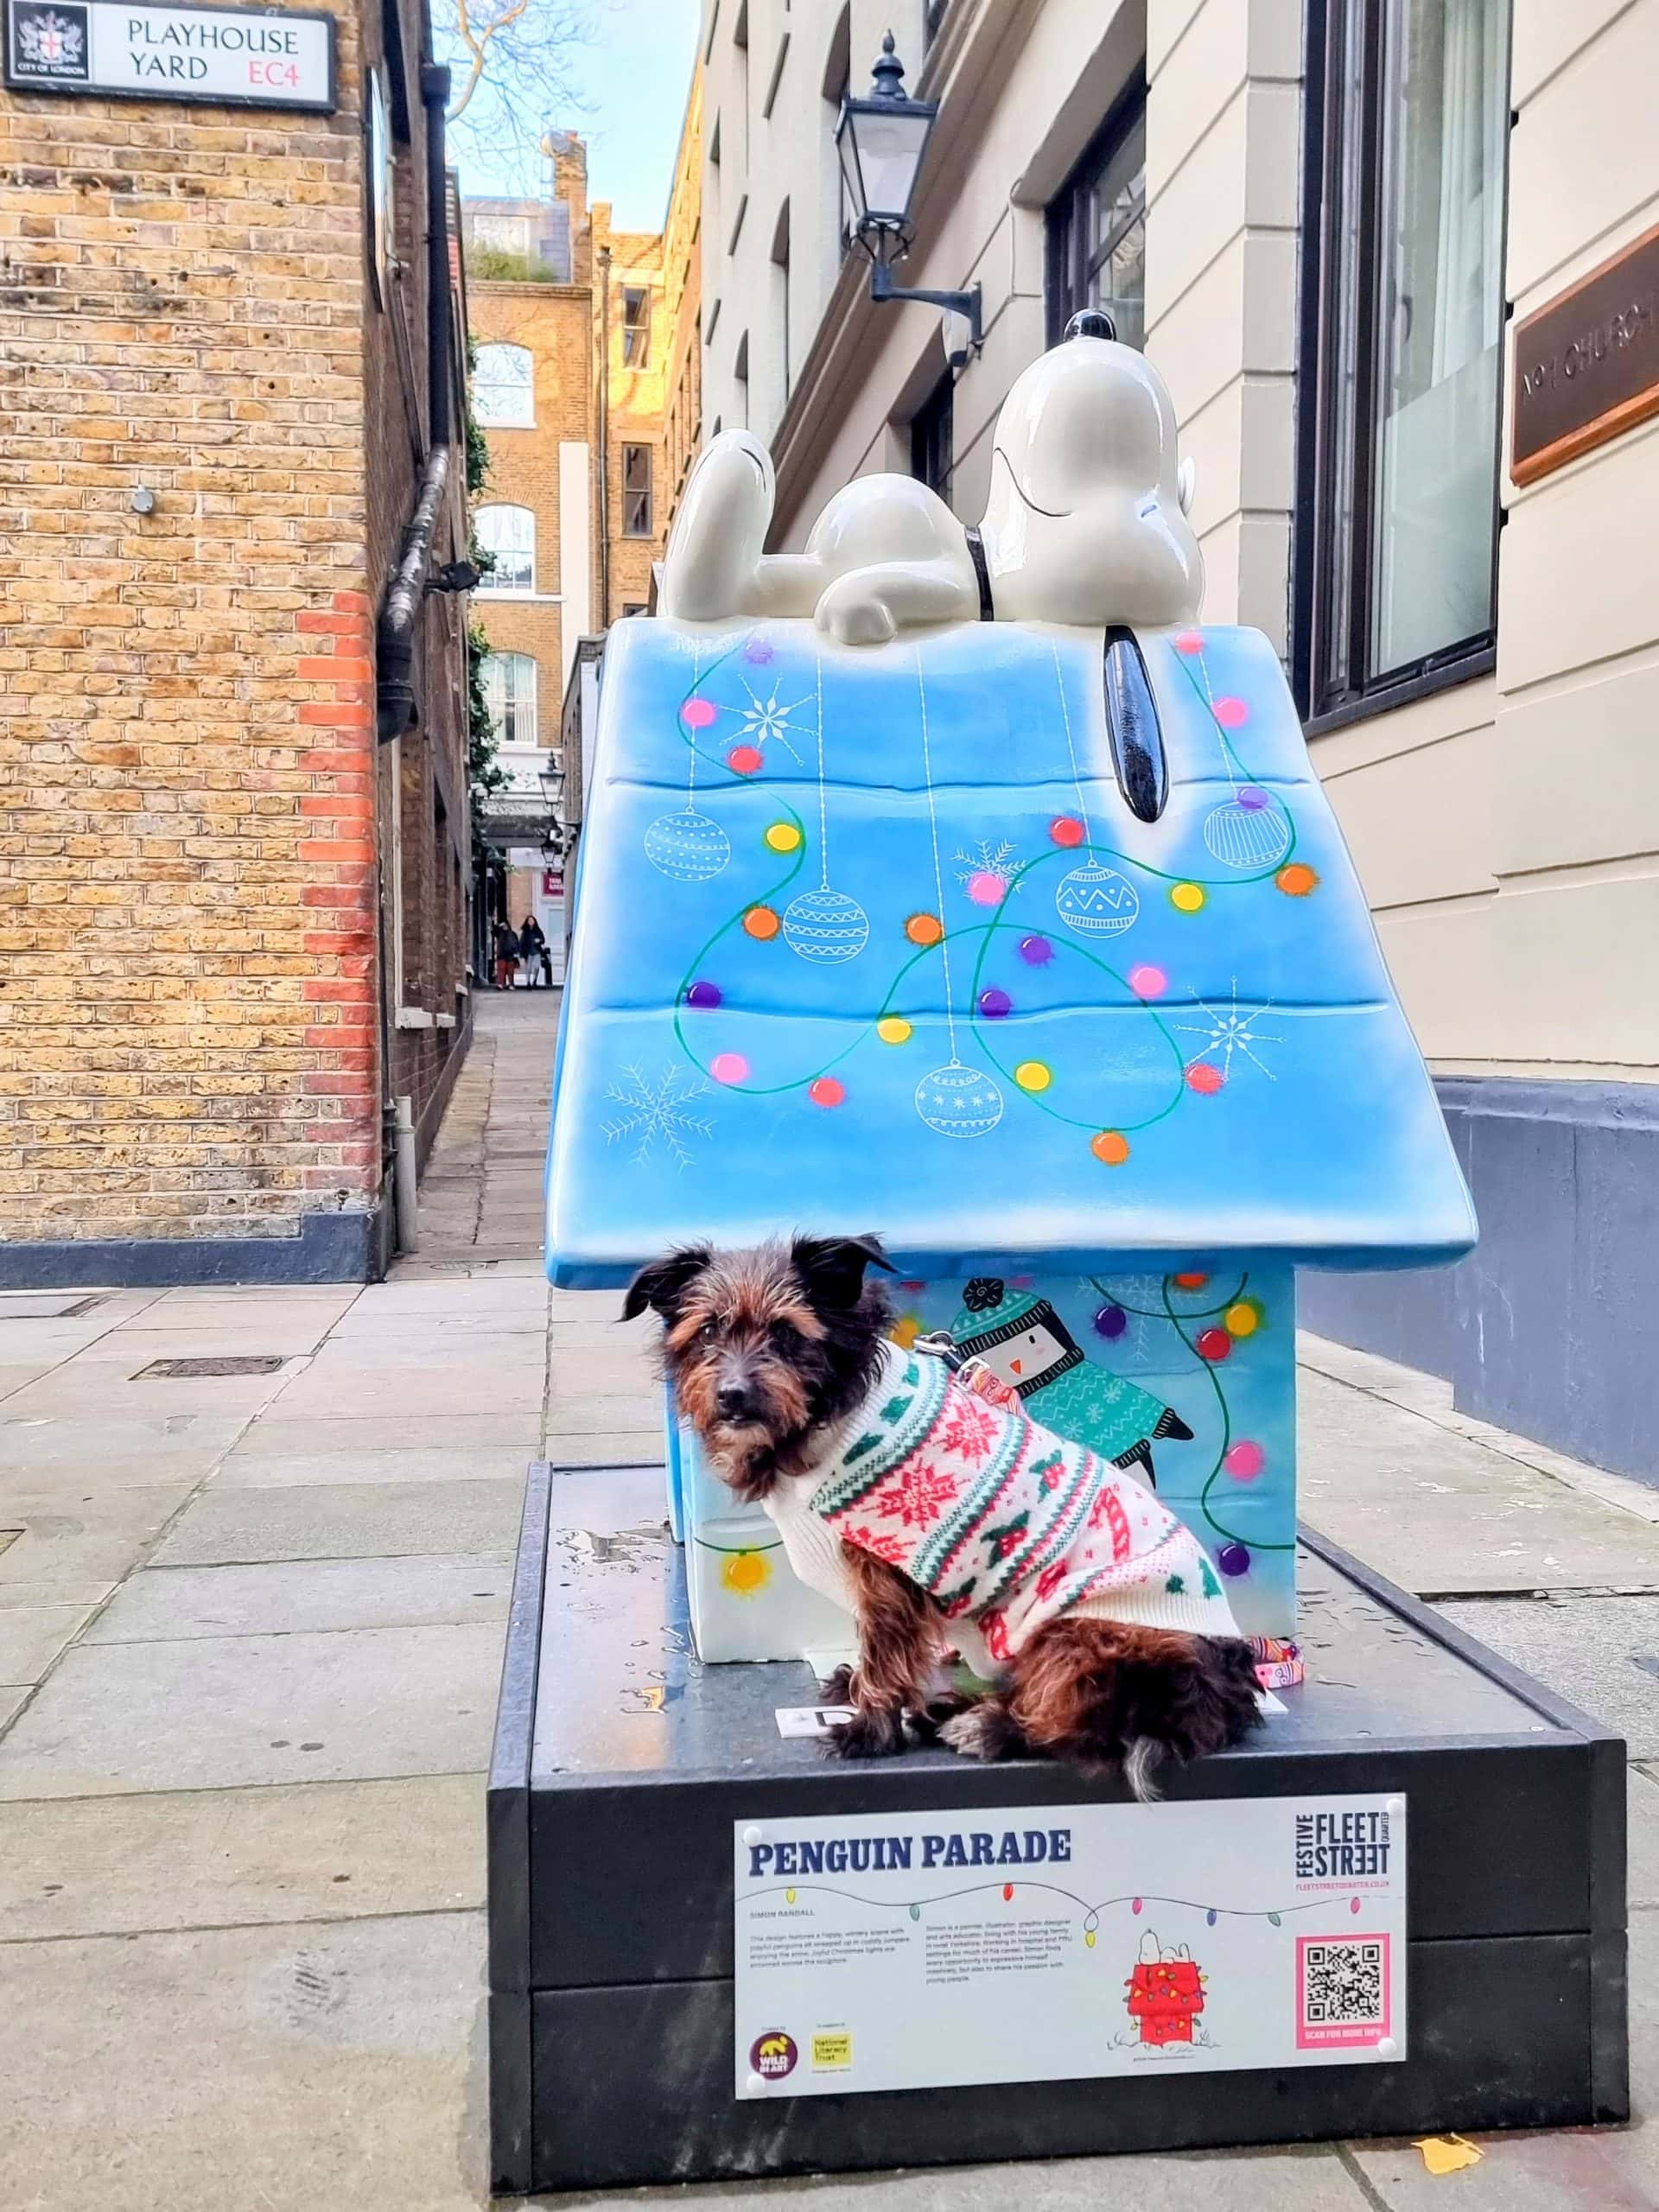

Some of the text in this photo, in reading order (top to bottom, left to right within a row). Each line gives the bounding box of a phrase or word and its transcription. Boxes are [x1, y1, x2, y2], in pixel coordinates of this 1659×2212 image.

[128, 19, 299, 54] PLAYHOUSE
[17, 62, 86, 75] CITY OF LONDON
[130, 53, 300, 86] YARD EC4
[1316, 1812, 1379, 1845] FLEET
[749, 1829, 1071, 1877] PENGUIN PARADE
[1296, 1815, 1313, 1878] FESTIVE
[1315, 1844, 1390, 1877] STREET
[759, 2056, 788, 2065] WILD
